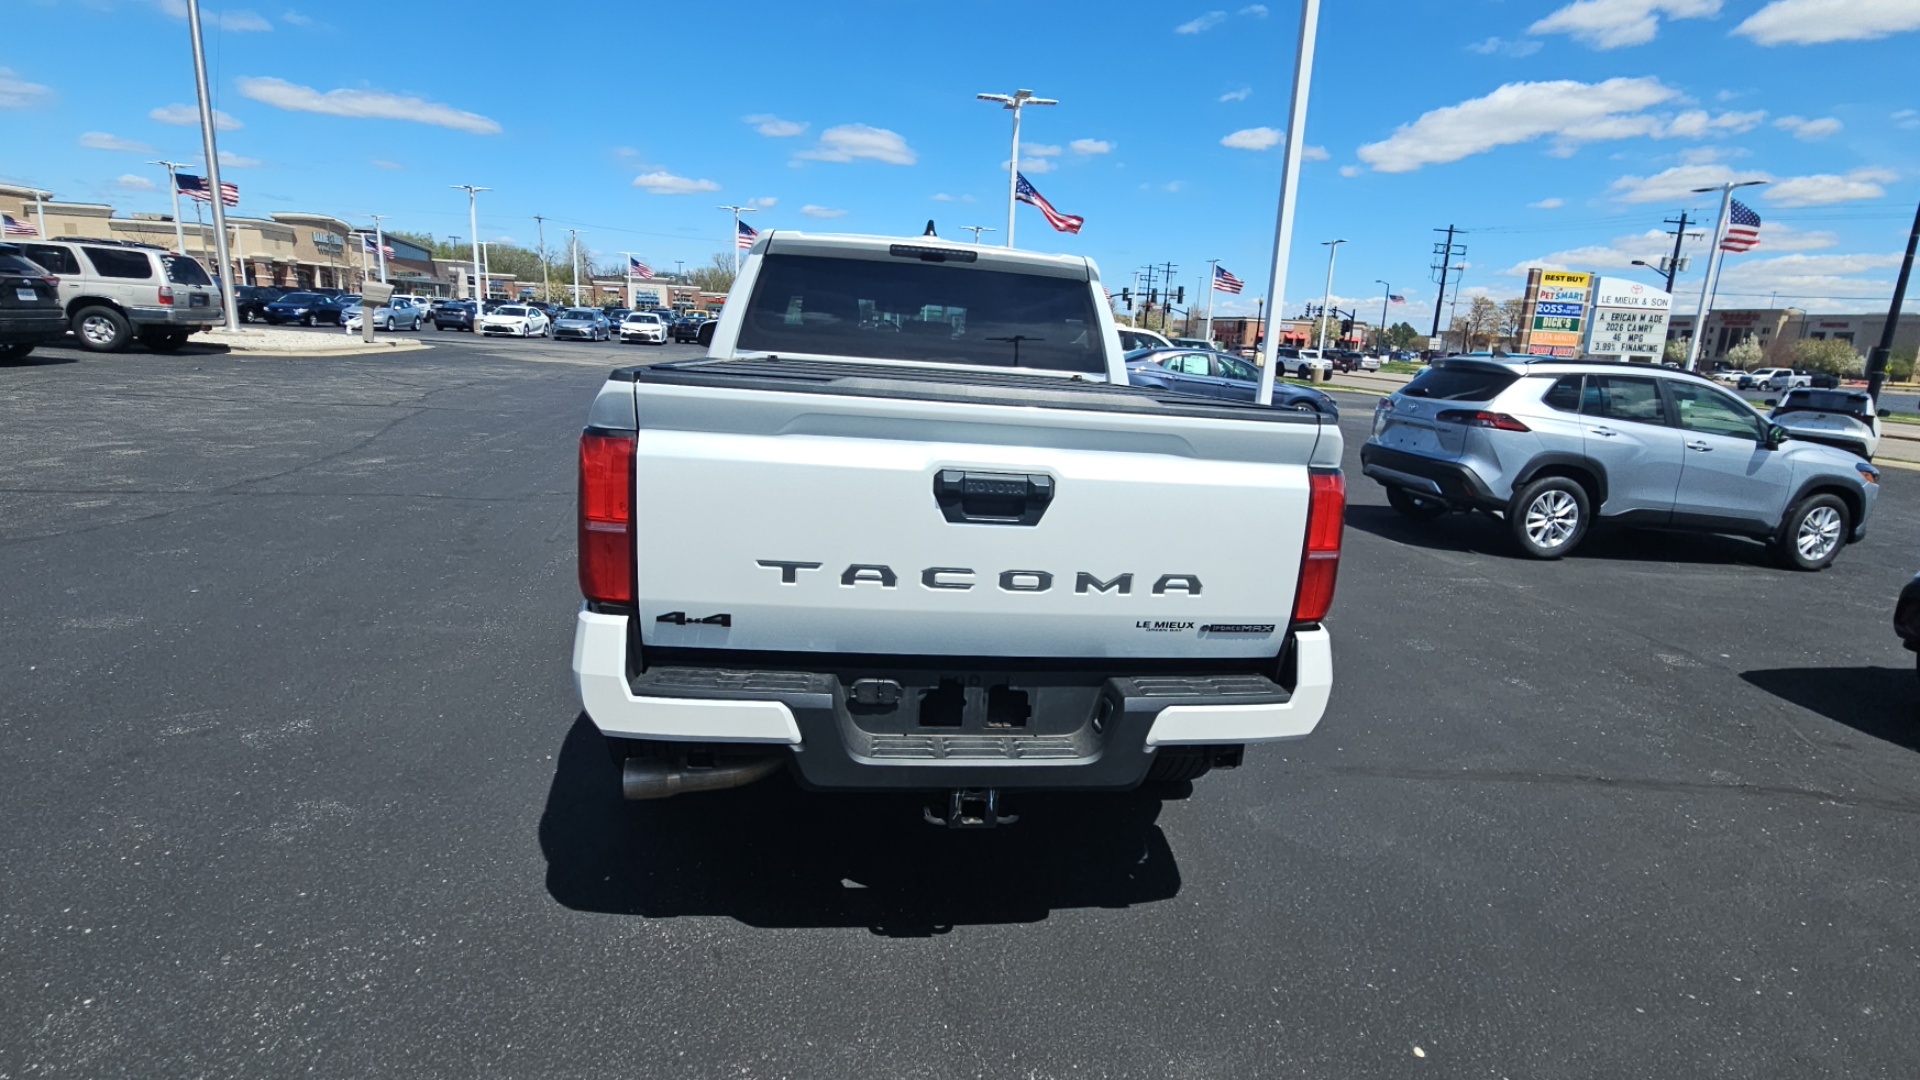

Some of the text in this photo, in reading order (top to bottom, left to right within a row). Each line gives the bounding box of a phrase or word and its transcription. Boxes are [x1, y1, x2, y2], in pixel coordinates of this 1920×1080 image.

[1601, 295, 1669, 307] LE MIEUX & SON
[1543, 317, 1572, 328] DICK'S
[1606, 323, 1654, 333] 2026 CAMRY
[1628, 334, 1643, 342] MPG
[1595, 342, 1658, 353] 3.99% FINANCING
[967, 482, 1025, 494] TOYOTA
[755, 560, 1203, 597] TACOMA
[1154, 621, 1195, 629] MIEUX
